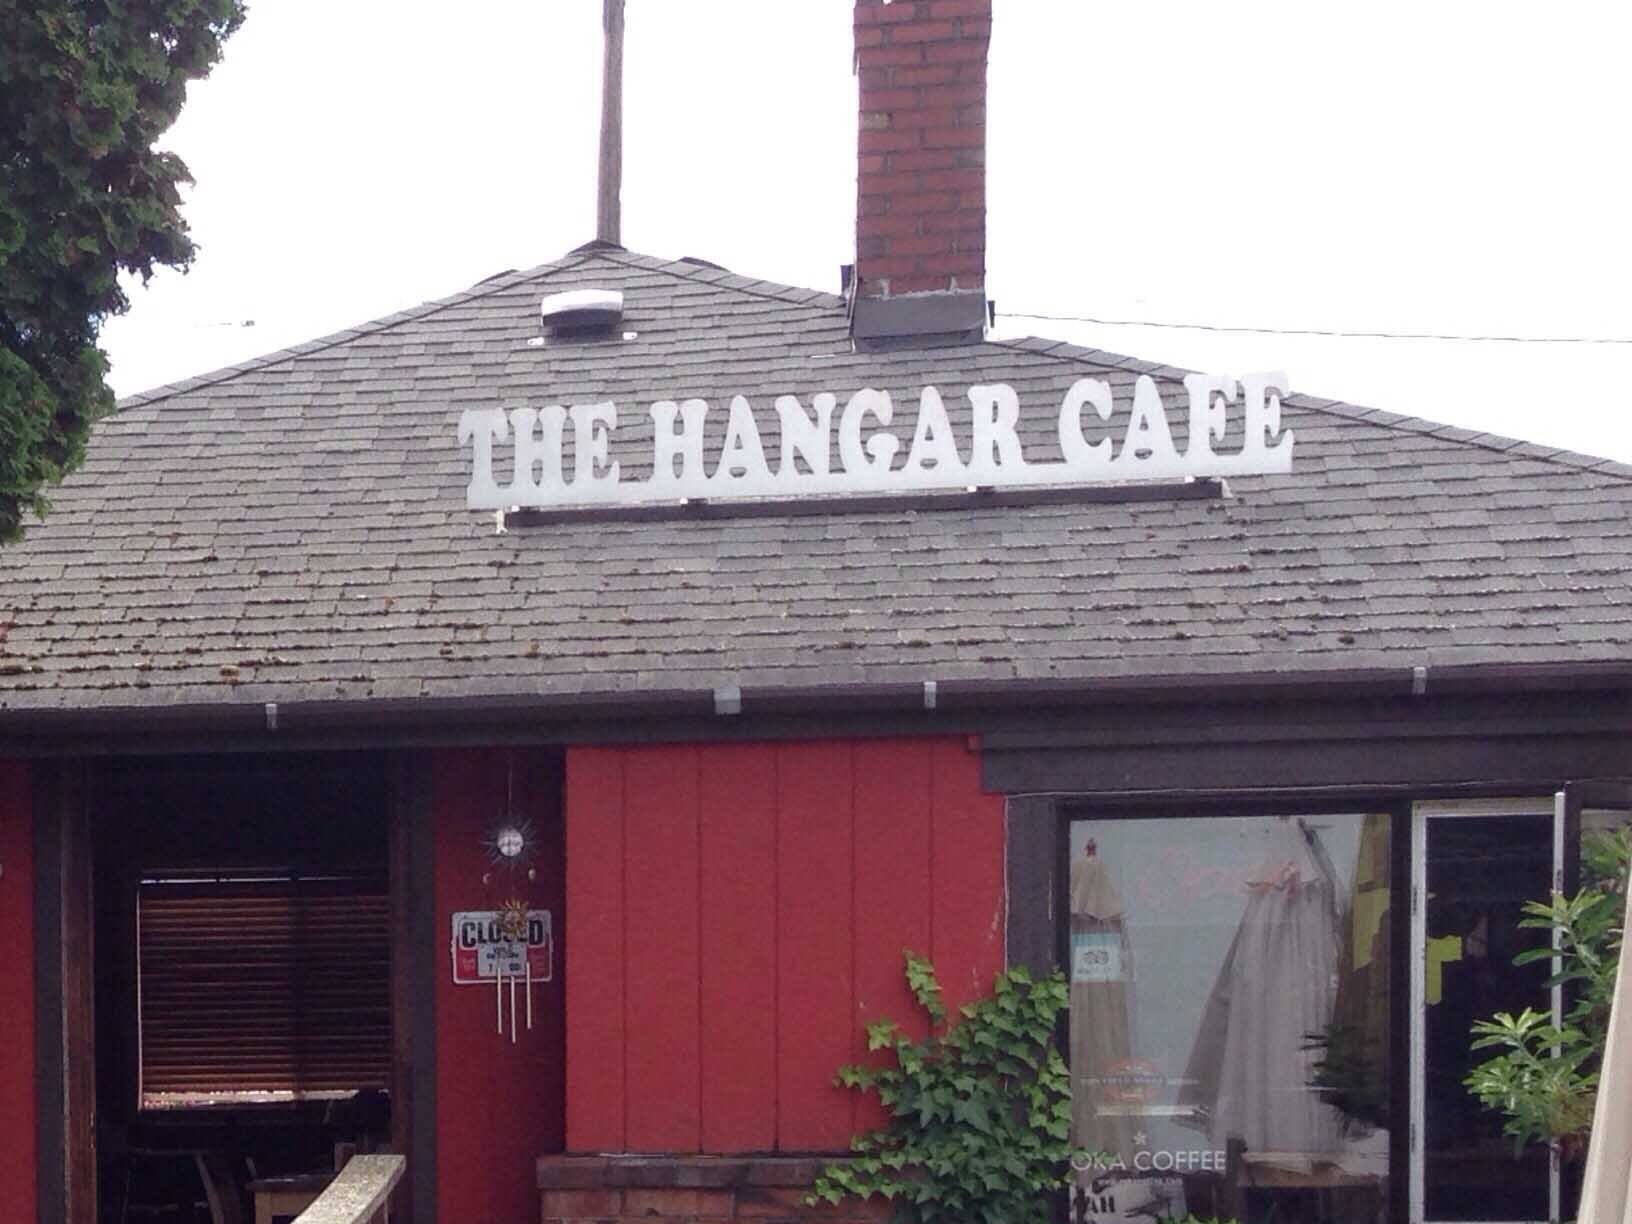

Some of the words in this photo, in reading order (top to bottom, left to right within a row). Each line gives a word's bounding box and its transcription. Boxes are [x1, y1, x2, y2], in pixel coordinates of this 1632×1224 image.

[458, 400, 620, 492] THE
[650, 382, 1028, 484] HANGAR
[1058, 370, 1295, 473] CAFE
[462, 919, 544, 948] CLOD
[1133, 1150, 1226, 1171] COFFEE
